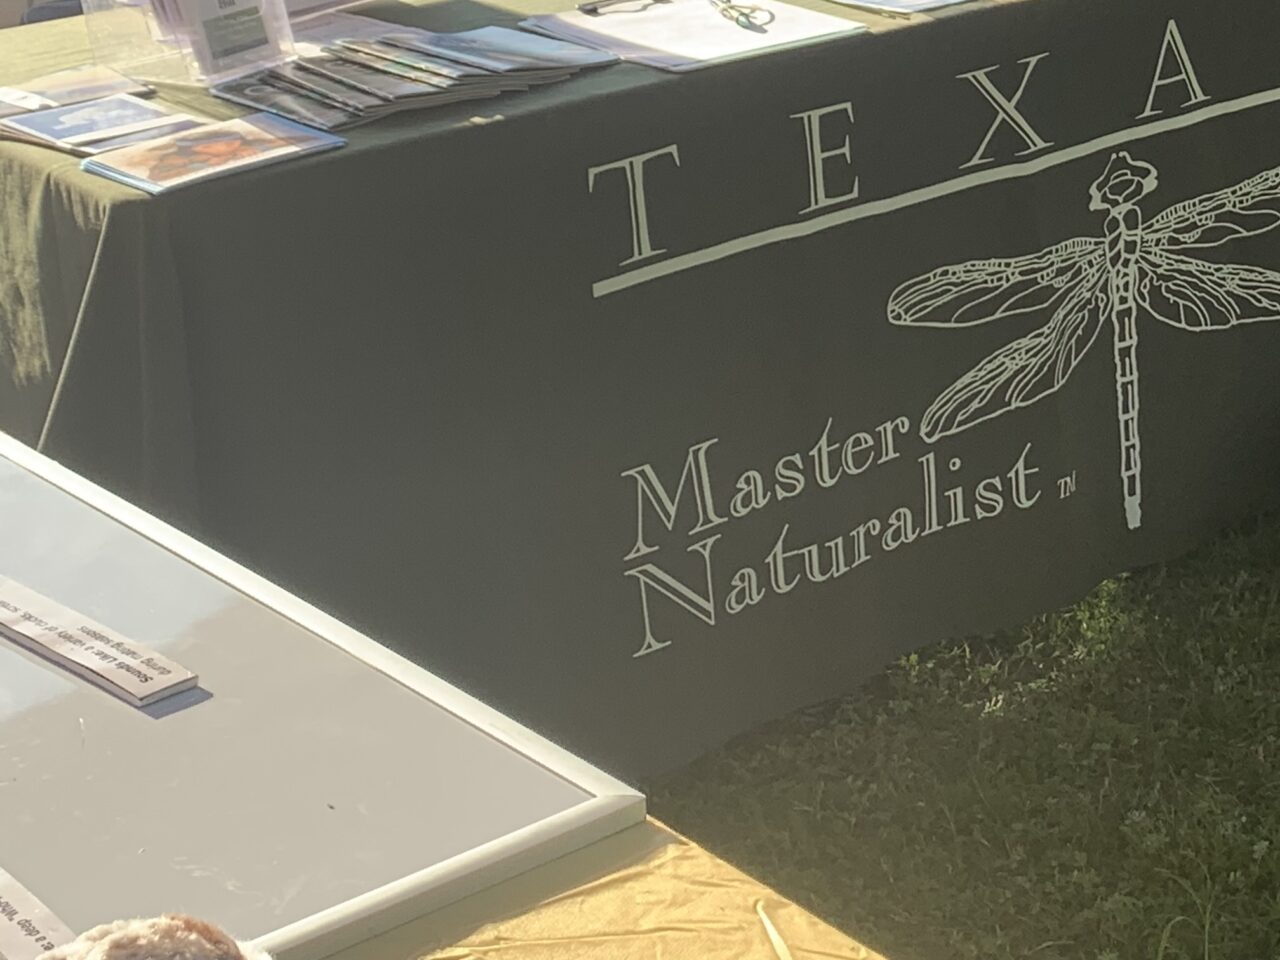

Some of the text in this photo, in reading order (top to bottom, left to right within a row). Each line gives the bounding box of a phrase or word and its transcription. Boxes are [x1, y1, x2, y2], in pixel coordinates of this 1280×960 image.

[622, 416, 910, 561] Master
[624, 442, 1042, 658] Naturalist
[115, 661, 154, 684] Sounds
[141, 657, 173, 676] during
[16, 918, 40, 937] deep
